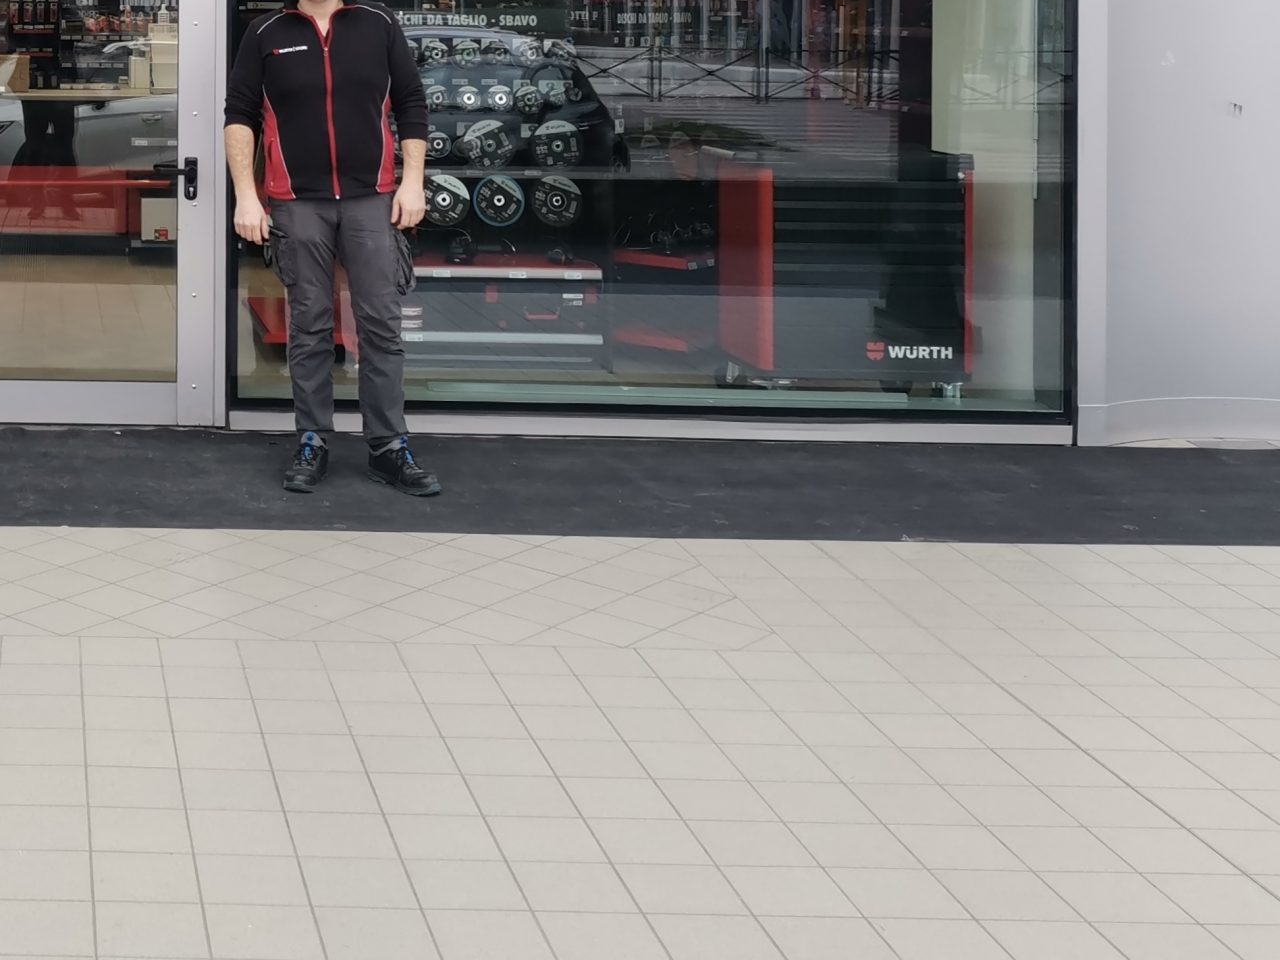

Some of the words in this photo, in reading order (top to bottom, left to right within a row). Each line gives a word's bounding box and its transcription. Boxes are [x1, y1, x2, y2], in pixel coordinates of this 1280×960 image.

[397, 14, 423, 26] SCHI
[426, 14, 443, 26] DA
[447, 14, 488, 26] TAGLIO
[498, 15, 538, 27] SBAVO
[888, 345, 953, 359] WÜRTH
